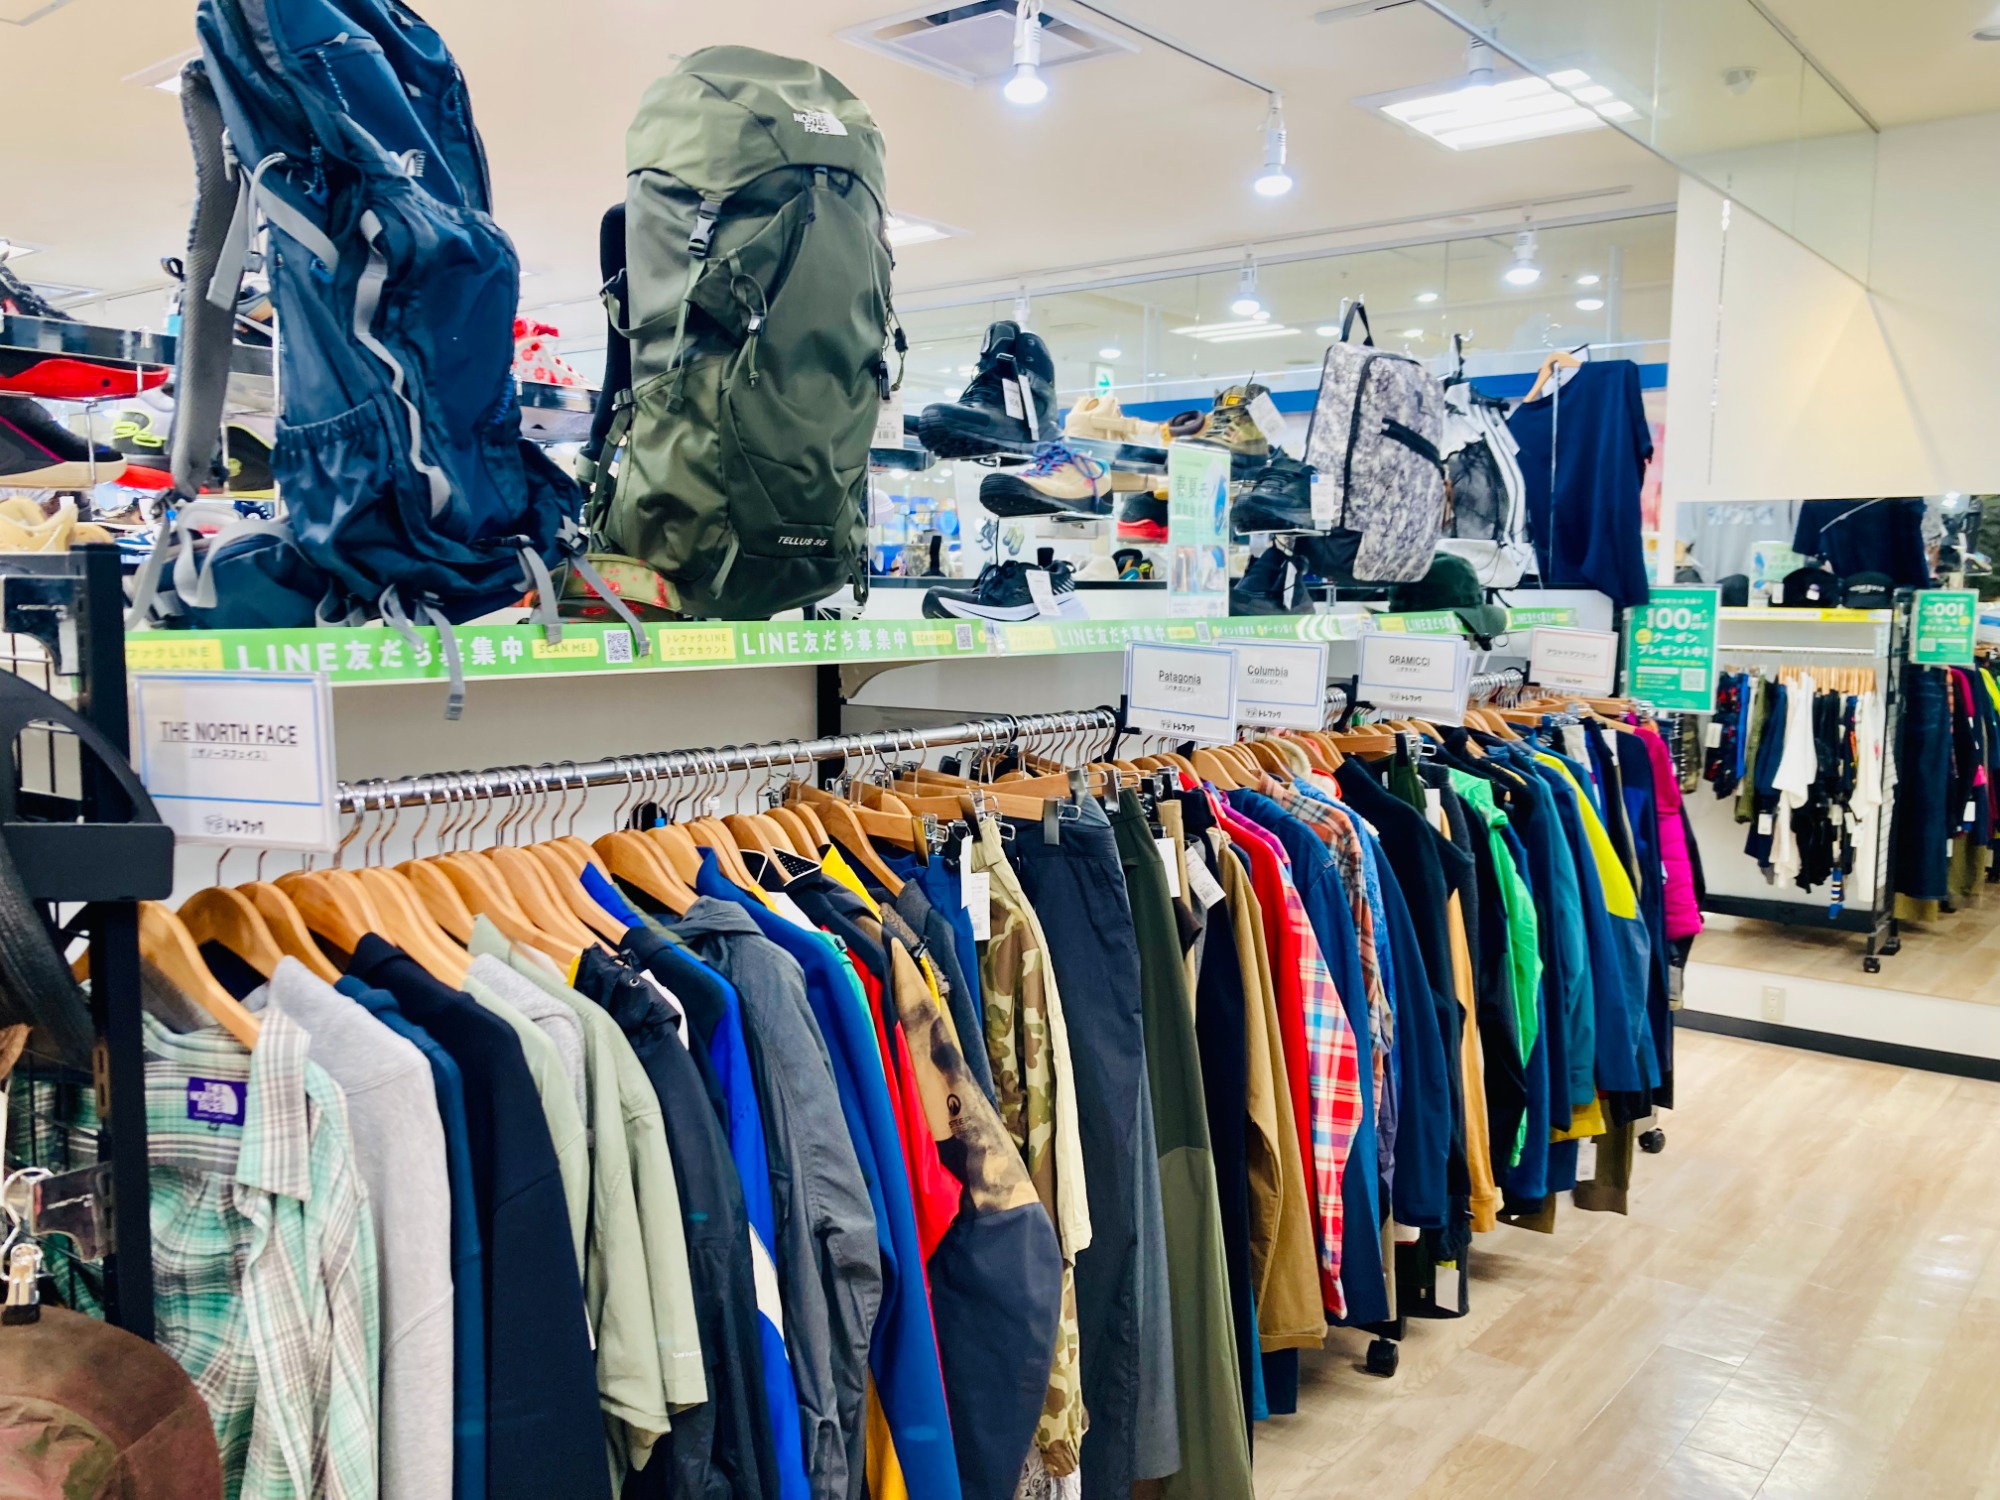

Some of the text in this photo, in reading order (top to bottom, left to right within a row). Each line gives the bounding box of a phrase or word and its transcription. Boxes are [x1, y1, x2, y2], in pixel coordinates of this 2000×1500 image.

[778, 536, 813, 546] TELLUS
[742, 628, 907, 655] LINE友だち募集中
[1389, 655, 1431, 668] GRAMICCI
[1158, 670, 1202, 685] Patagonia
[1247, 665, 1289, 677] Columbia
[160, 721, 298, 745] THE NORTH FACE
